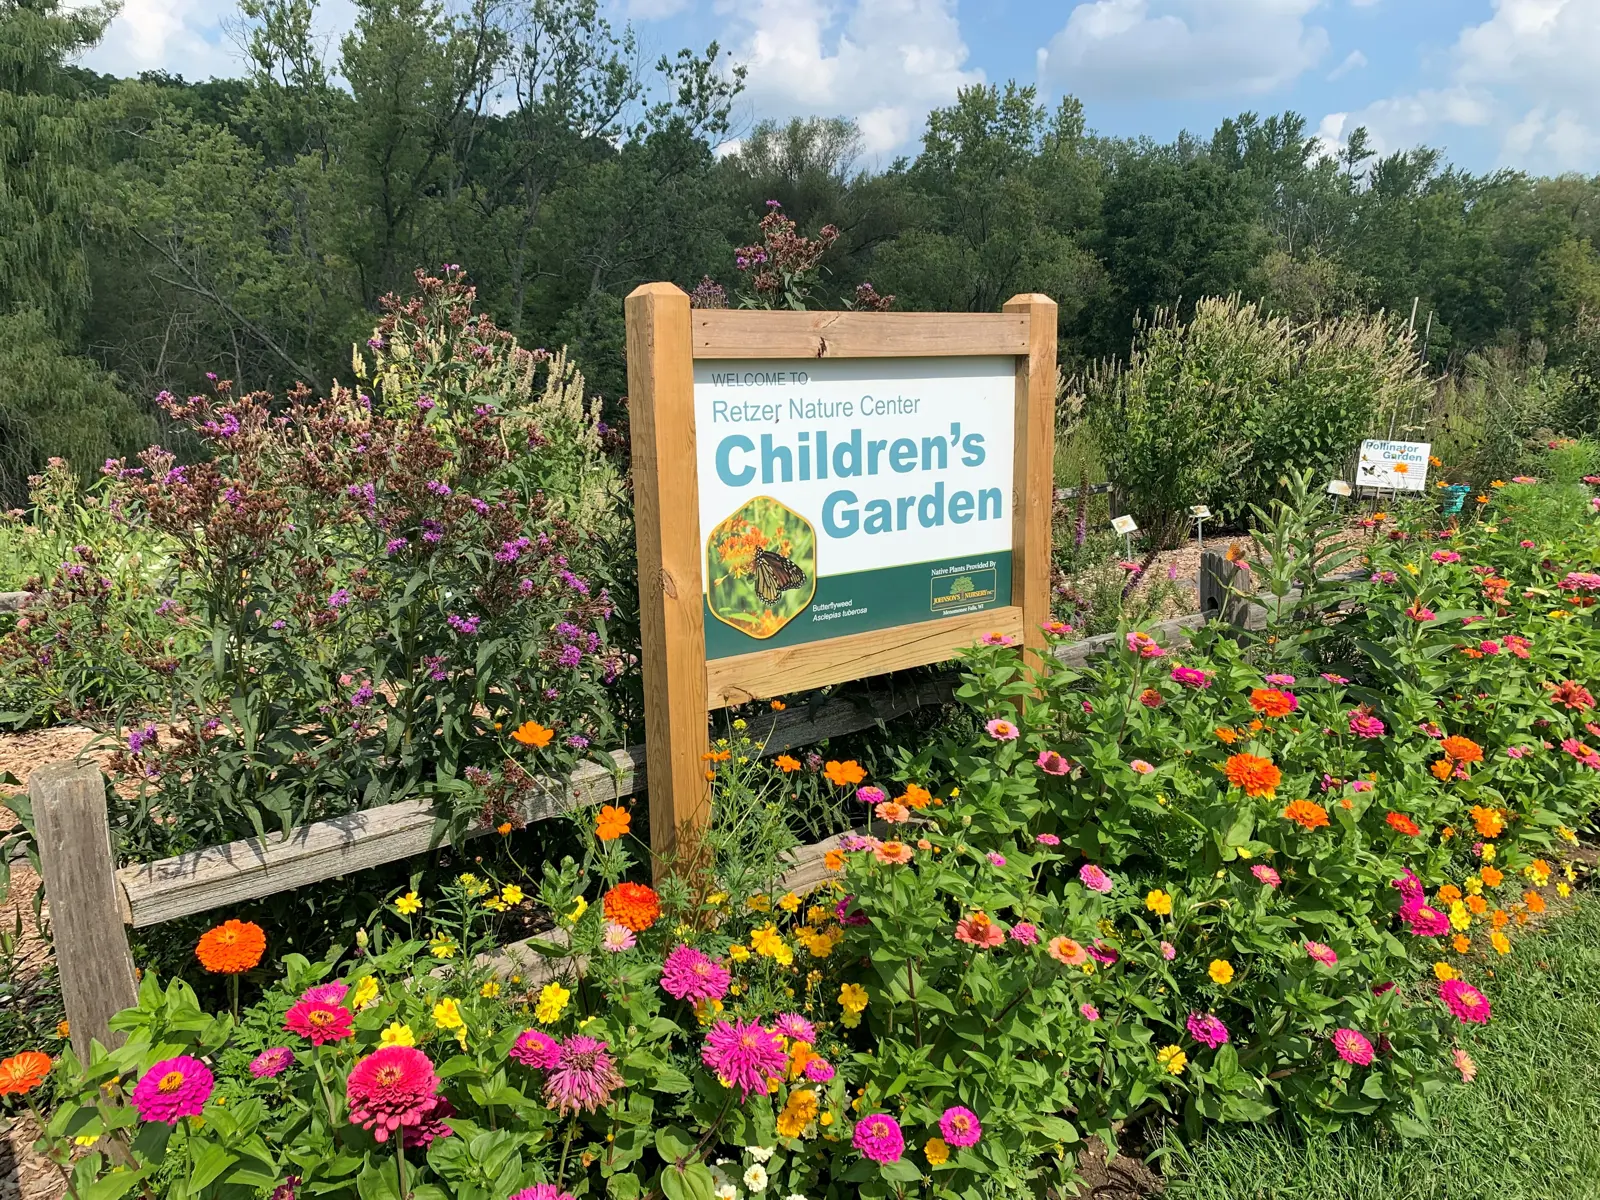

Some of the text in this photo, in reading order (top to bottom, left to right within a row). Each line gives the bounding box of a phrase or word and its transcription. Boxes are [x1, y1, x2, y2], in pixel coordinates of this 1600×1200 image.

[712, 371, 809, 387] WELCOME TO
[712, 395, 920, 423] Retzer Nature Center
[715, 422, 986, 487] Children's
[1365, 441, 1419, 453] Pollinator
[821, 481, 1002, 539] Garden
[949, 566, 965, 574] Plants
[966, 561, 989, 571] Provided
[989, 560, 996, 568] By
[965, 589, 987, 599] NURSERY
[812, 599, 853, 612] Butterflyweed
[812, 607, 868, 622] Asclepias tuberosa
